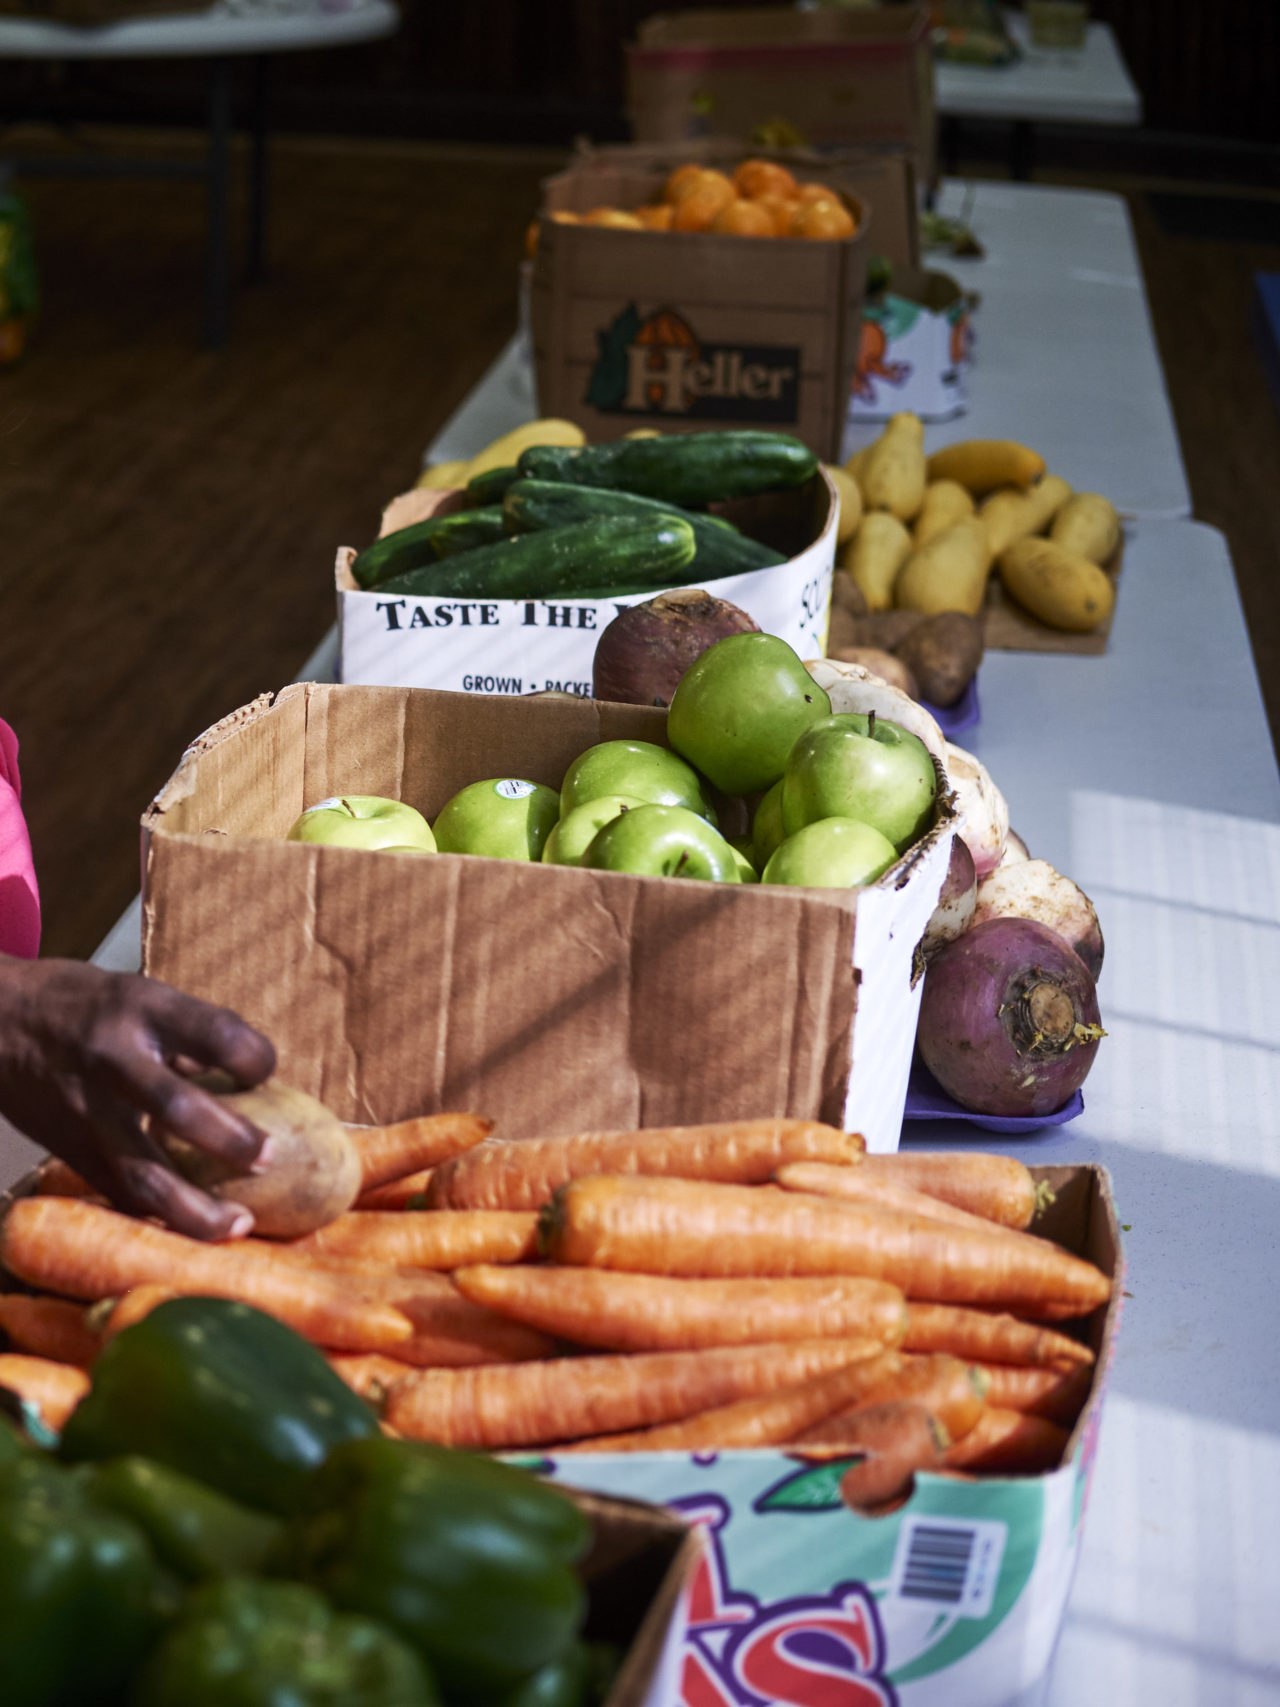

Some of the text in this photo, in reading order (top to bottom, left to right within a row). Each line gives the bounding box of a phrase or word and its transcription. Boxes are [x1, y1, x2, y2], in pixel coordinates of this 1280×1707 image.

[624, 346, 795, 413] Heller
[375, 599, 501, 632] TASTE
[514, 599, 598, 631] THE
[462, 674, 596, 699] GROWN PACKE
